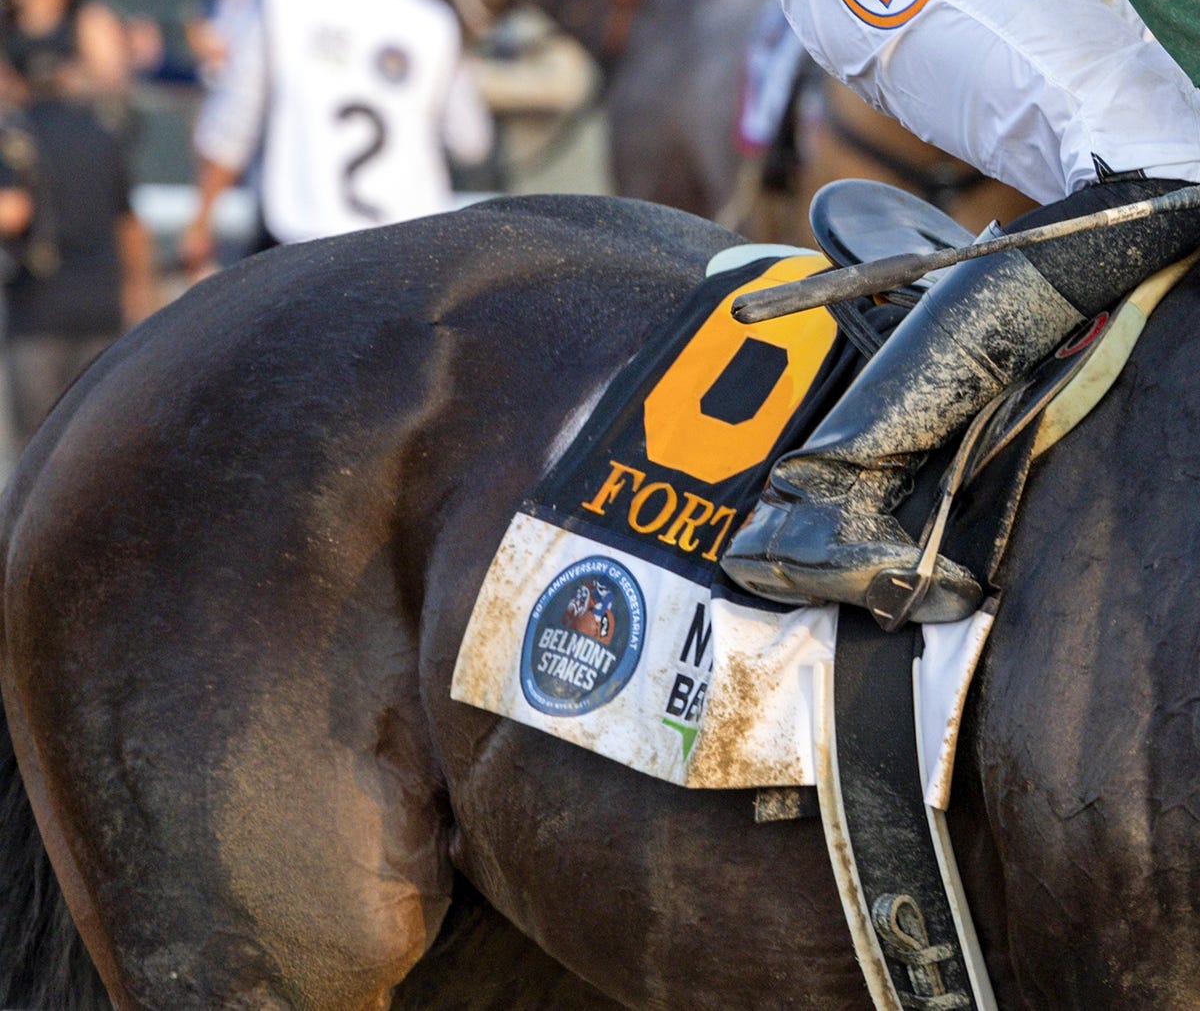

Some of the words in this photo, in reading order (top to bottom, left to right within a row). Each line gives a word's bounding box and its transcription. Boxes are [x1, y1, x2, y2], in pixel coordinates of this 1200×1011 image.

[335, 101, 388, 224] 2
[548, 561, 609, 597] ANNIVERSARY
[609, 567, 622, 581] OF
[619, 576, 642, 651] SECRETARIAT
[679, 601, 714, 673] N
[537, 652, 597, 691] STAKES
[538, 628, 616, 674] BELMONT
